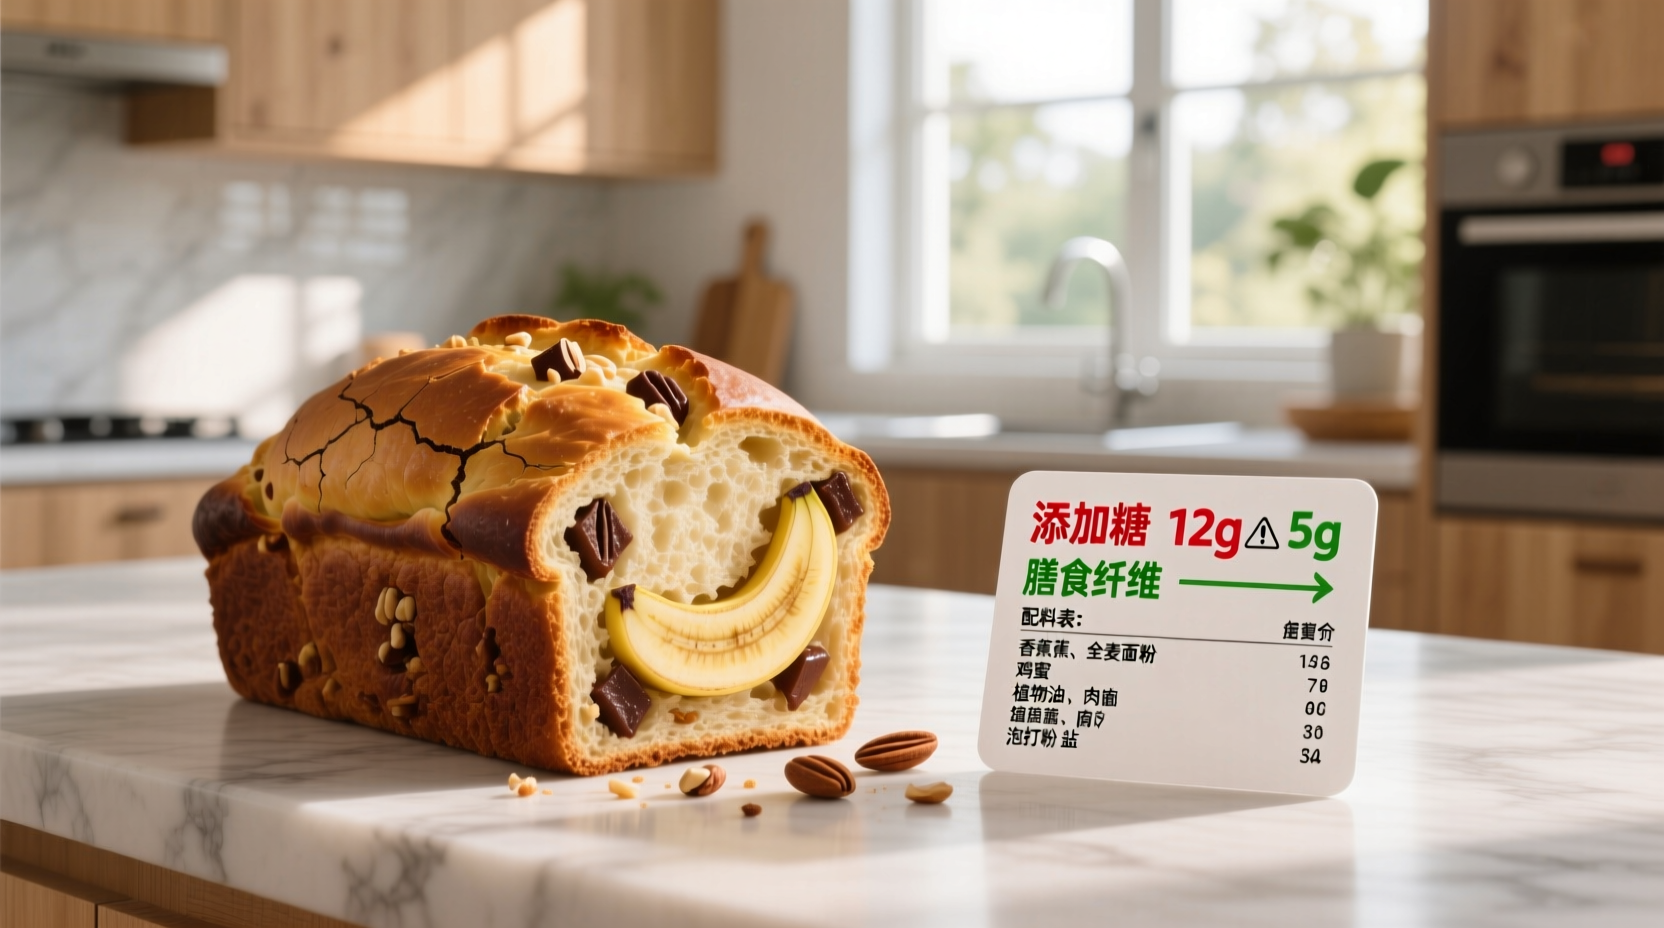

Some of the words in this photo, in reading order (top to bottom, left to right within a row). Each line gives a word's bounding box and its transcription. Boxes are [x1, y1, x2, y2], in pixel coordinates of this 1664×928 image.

[1029, 500, 1152, 547] 添加糖
[1168, 507, 1243, 560] 12g
[1287, 510, 1343, 562] 5g
[1022, 557, 1163, 600] 膳食纤维
